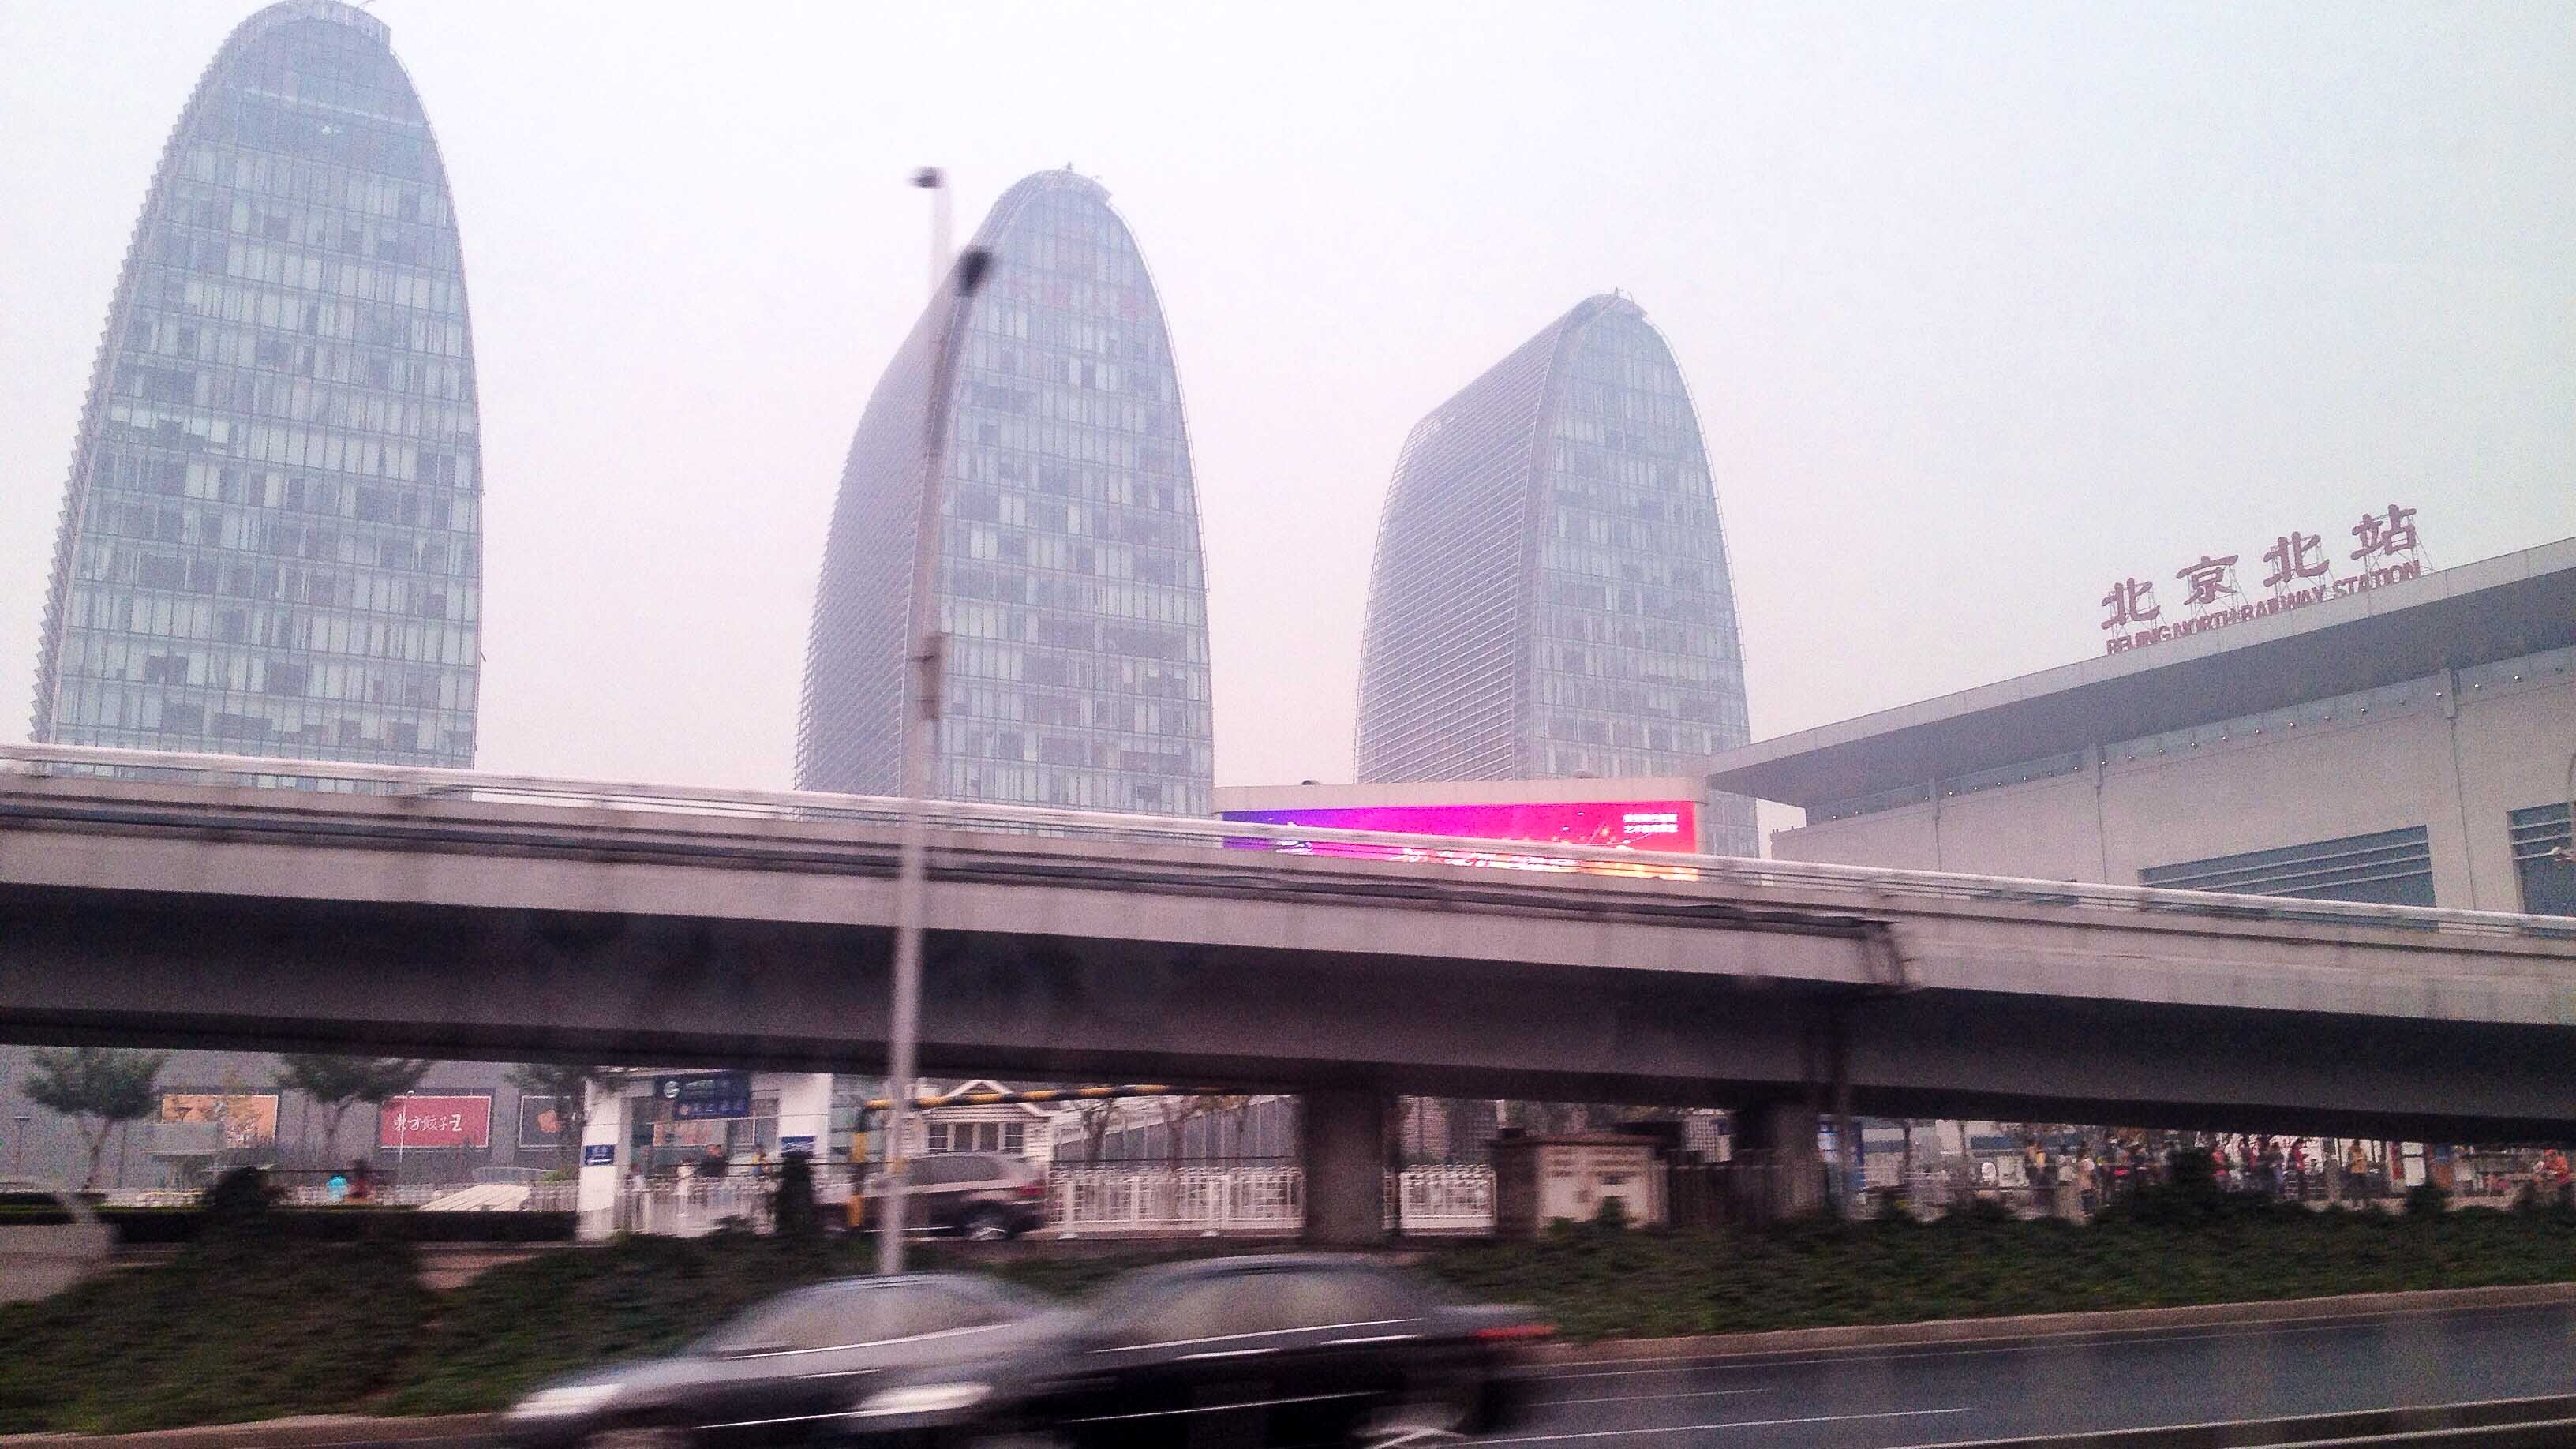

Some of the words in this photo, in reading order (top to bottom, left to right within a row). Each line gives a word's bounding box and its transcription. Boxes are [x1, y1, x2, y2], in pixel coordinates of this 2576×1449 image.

[2101, 504, 2417, 631] 北京北站
[2106, 623, 2172, 655] BEIJING
[2173, 608, 2238, 638] NORTH
[2241, 584, 2327, 622] RAILWAY
[2332, 560, 2422, 598] STATION
